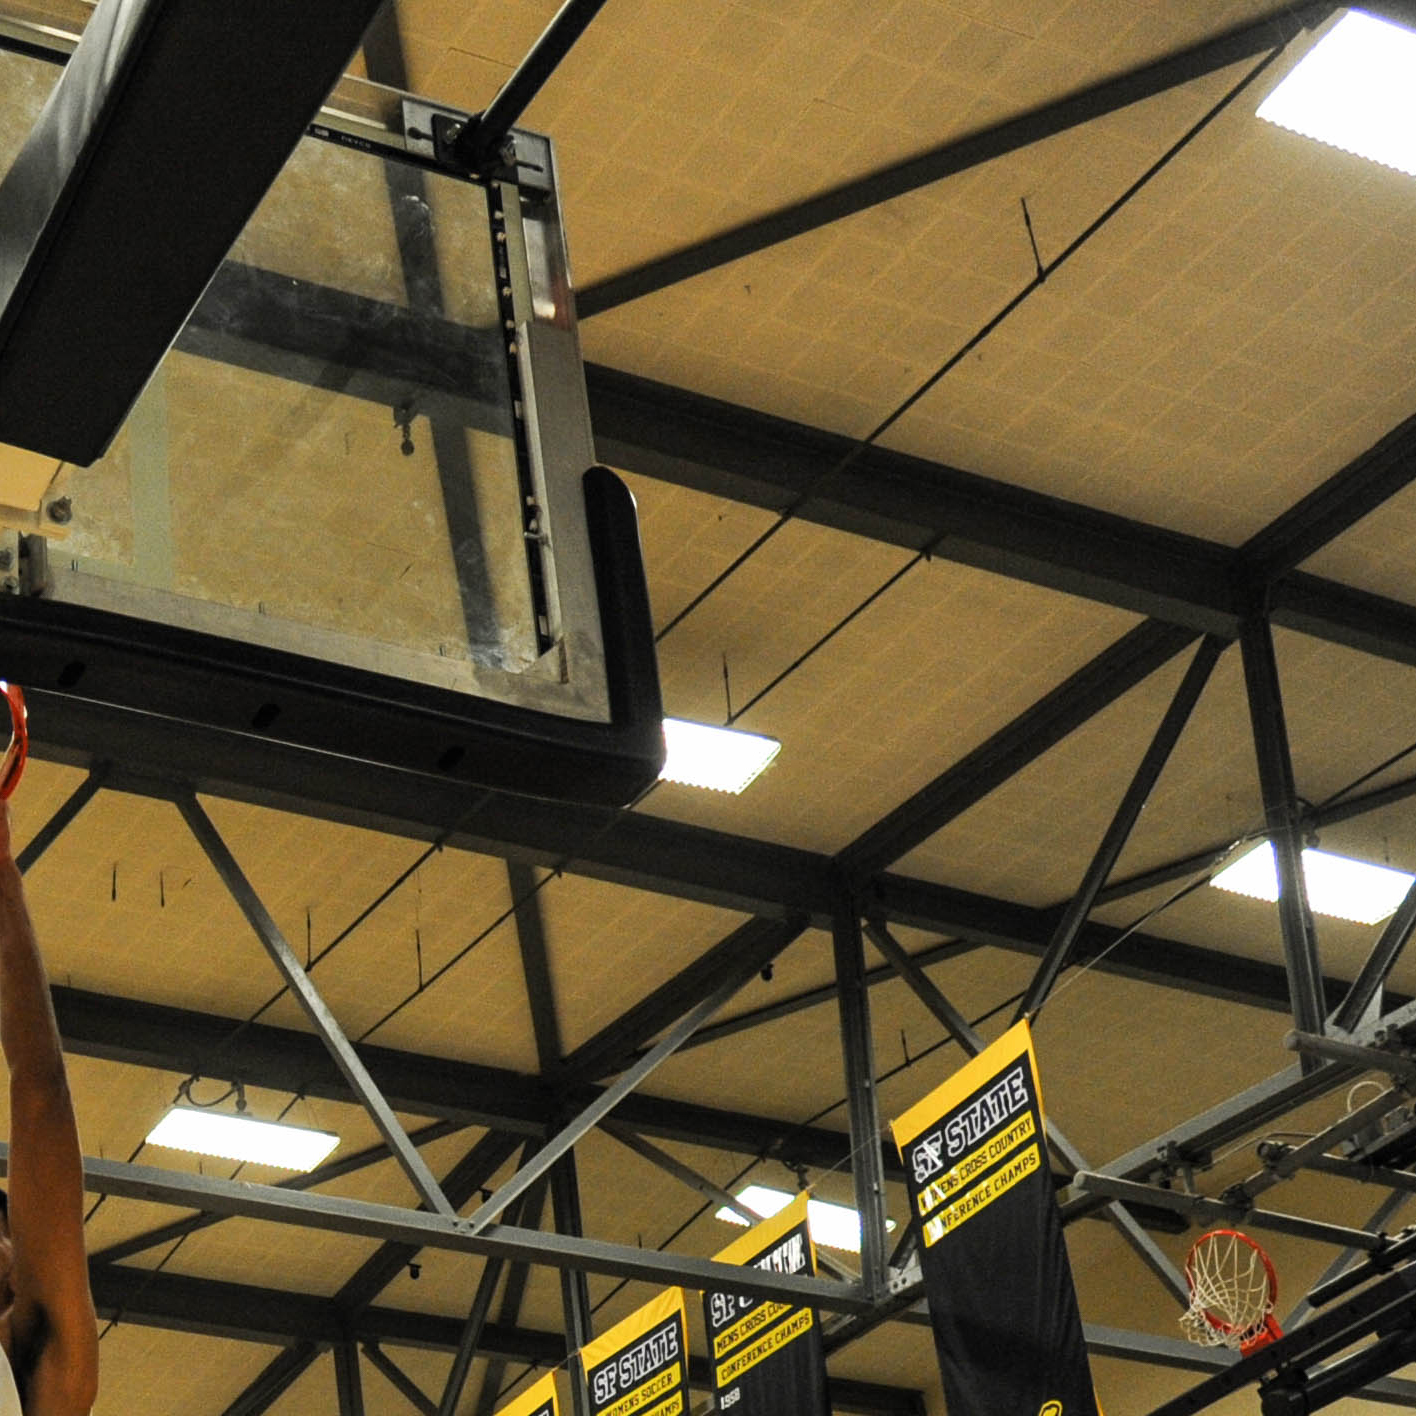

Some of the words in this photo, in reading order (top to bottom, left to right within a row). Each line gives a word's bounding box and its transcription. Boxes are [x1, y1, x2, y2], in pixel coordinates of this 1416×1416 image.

[945, 1066, 1029, 1158] STATE
[959, 1151, 988, 1181] CROSS
[988, 1117, 1033, 1159] COUNTRY
[994, 1151, 1037, 1193] CHAMPS
[594, 1362, 617, 1405] SF
[619, 1322, 678, 1388] STATE
[717, 1329, 740, 1354] MENS
[739, 1309, 768, 1336] CROSS
[721, 1338, 774, 1382] CONFERENCE
[774, 1313, 810, 1346] CHAMPS
[640, 1372, 673, 1402] SOCCER
